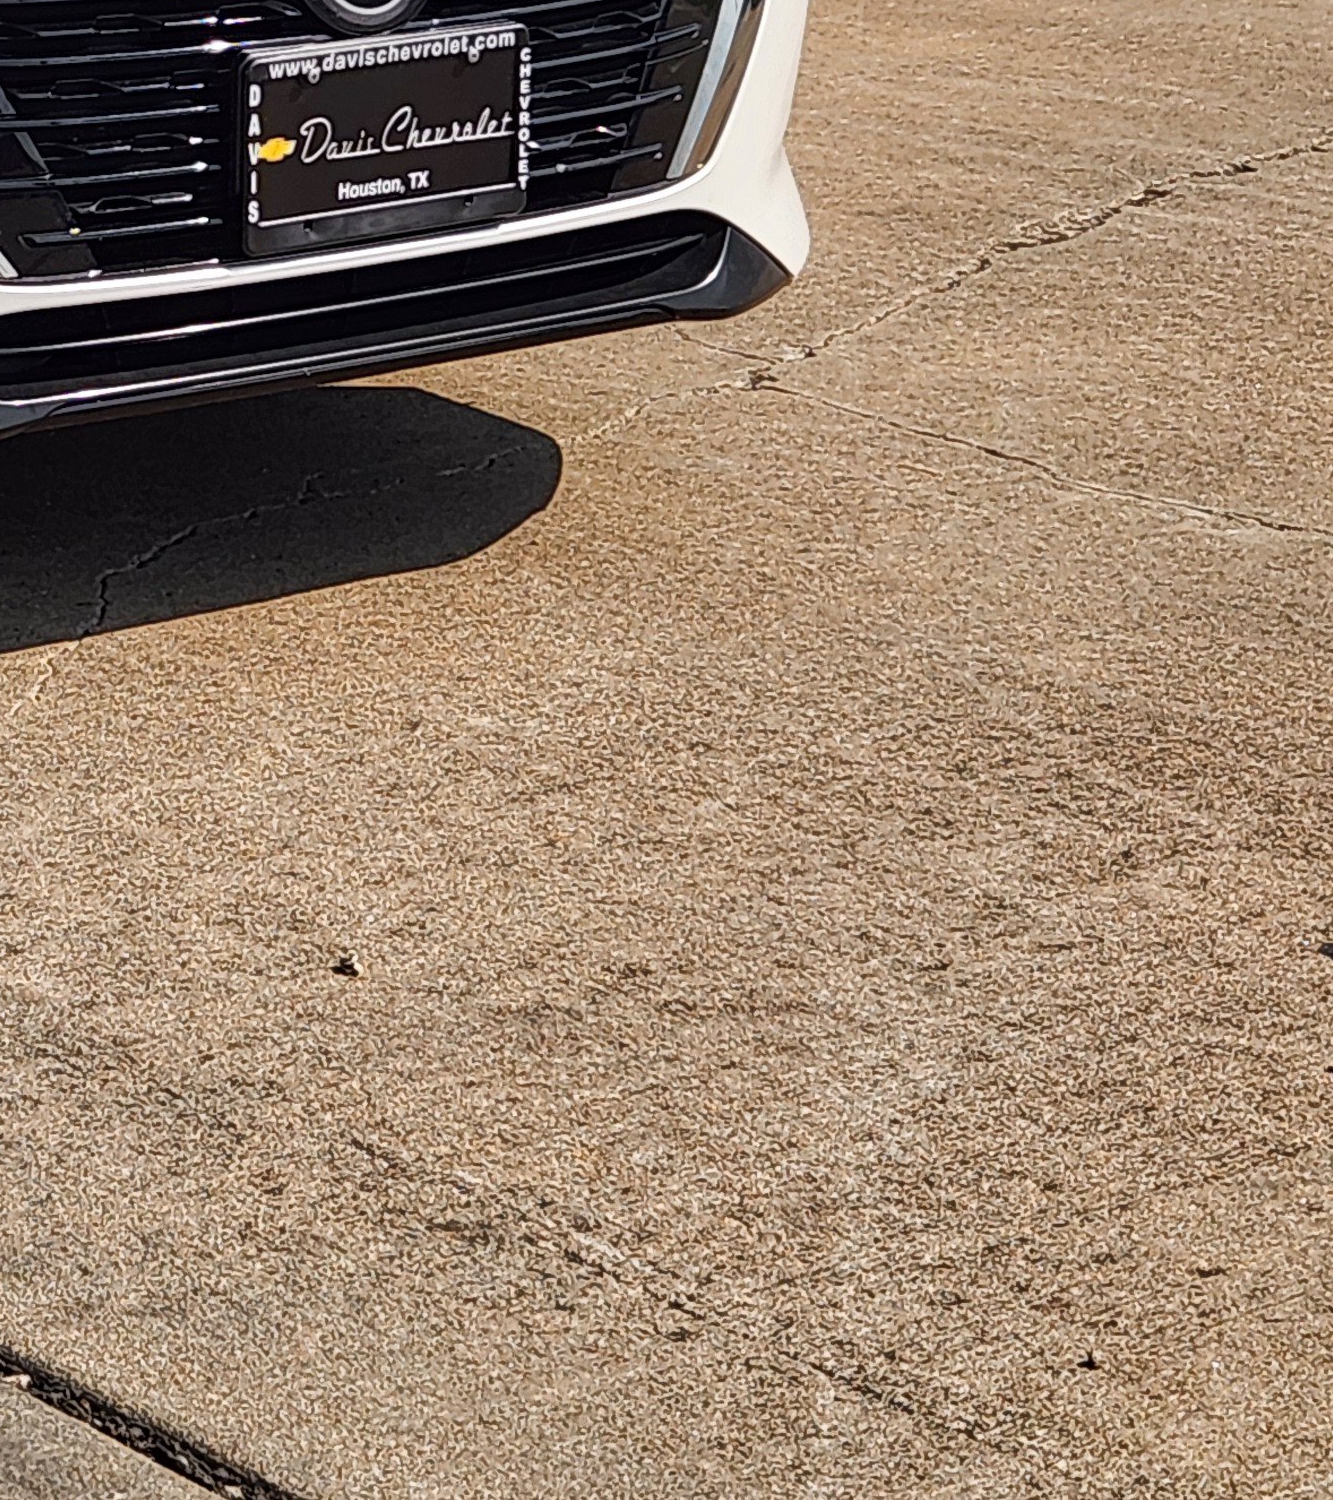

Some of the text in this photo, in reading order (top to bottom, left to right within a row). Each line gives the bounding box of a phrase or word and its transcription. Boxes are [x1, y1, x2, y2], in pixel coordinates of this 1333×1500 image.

[269, 31, 516, 80] www.davischevrolet.com
[299, 106, 515, 163] Davis Chevrolet
[518, 48, 531, 190] CHEVROLET
[248, 84, 261, 224] DAVIS
[338, 170, 430, 200] Houston, TX
